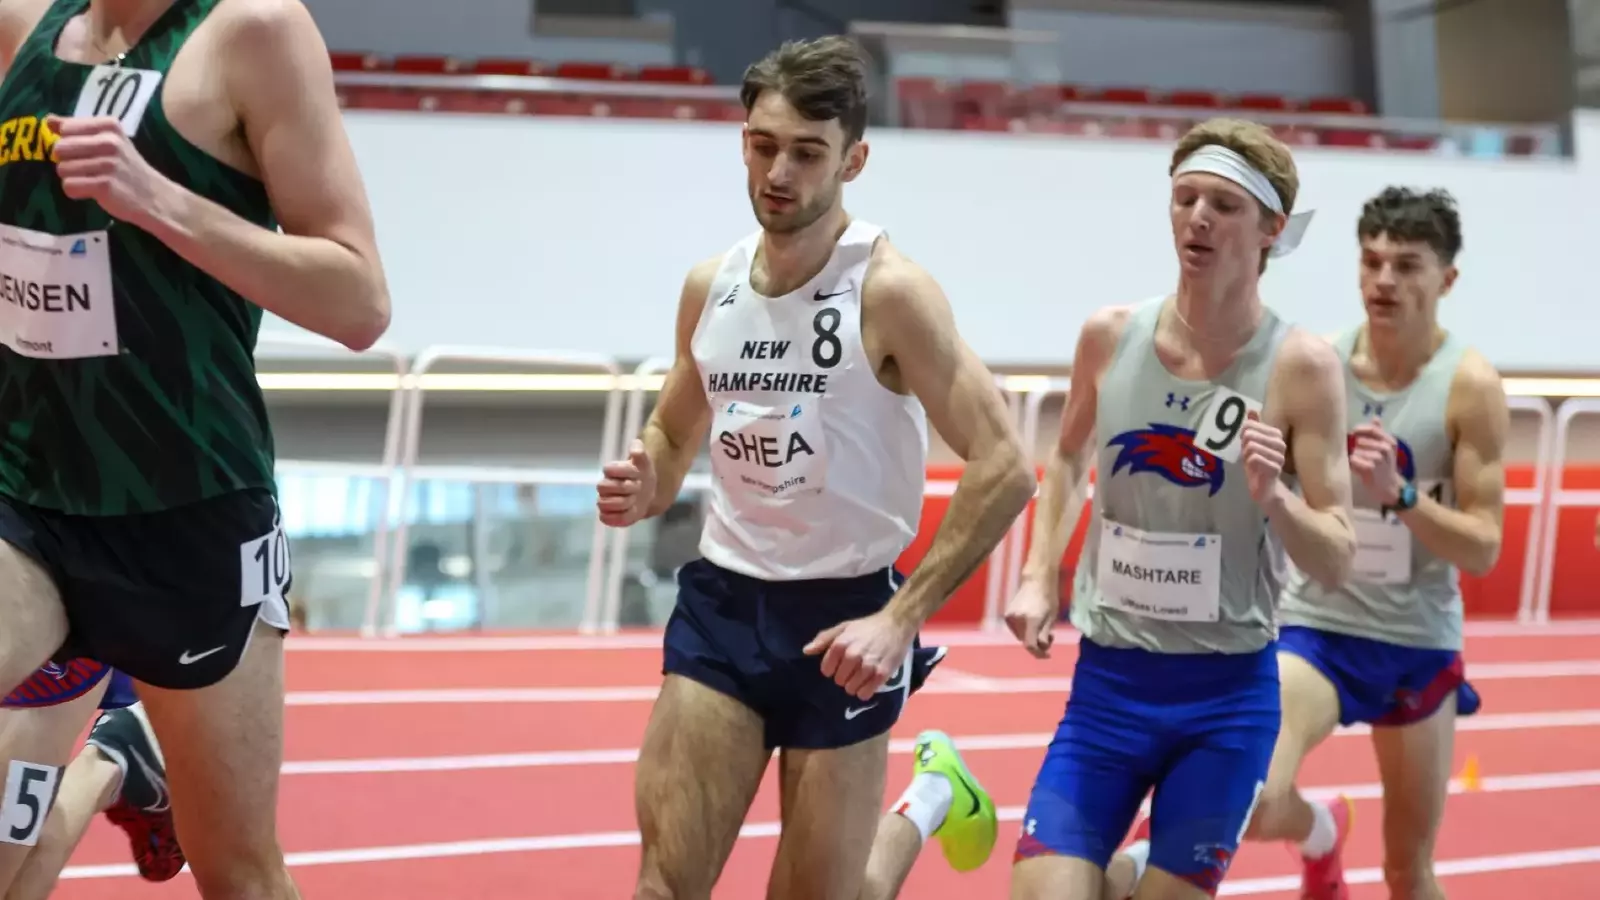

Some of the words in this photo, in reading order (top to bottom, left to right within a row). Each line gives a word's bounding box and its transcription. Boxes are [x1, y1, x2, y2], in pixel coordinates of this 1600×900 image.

[92, 72, 142, 123] 10
[740, 341, 791, 359] NEW
[812, 307, 842, 369] 8
[708, 373, 828, 393] HAMPSHIRE
[719, 430, 815, 468] SHEA
[1205, 396, 1246, 451] 9
[254, 528, 285, 596] 10
[1112, 558, 1203, 585] MASHTARE
[10, 767, 48, 841] 5
